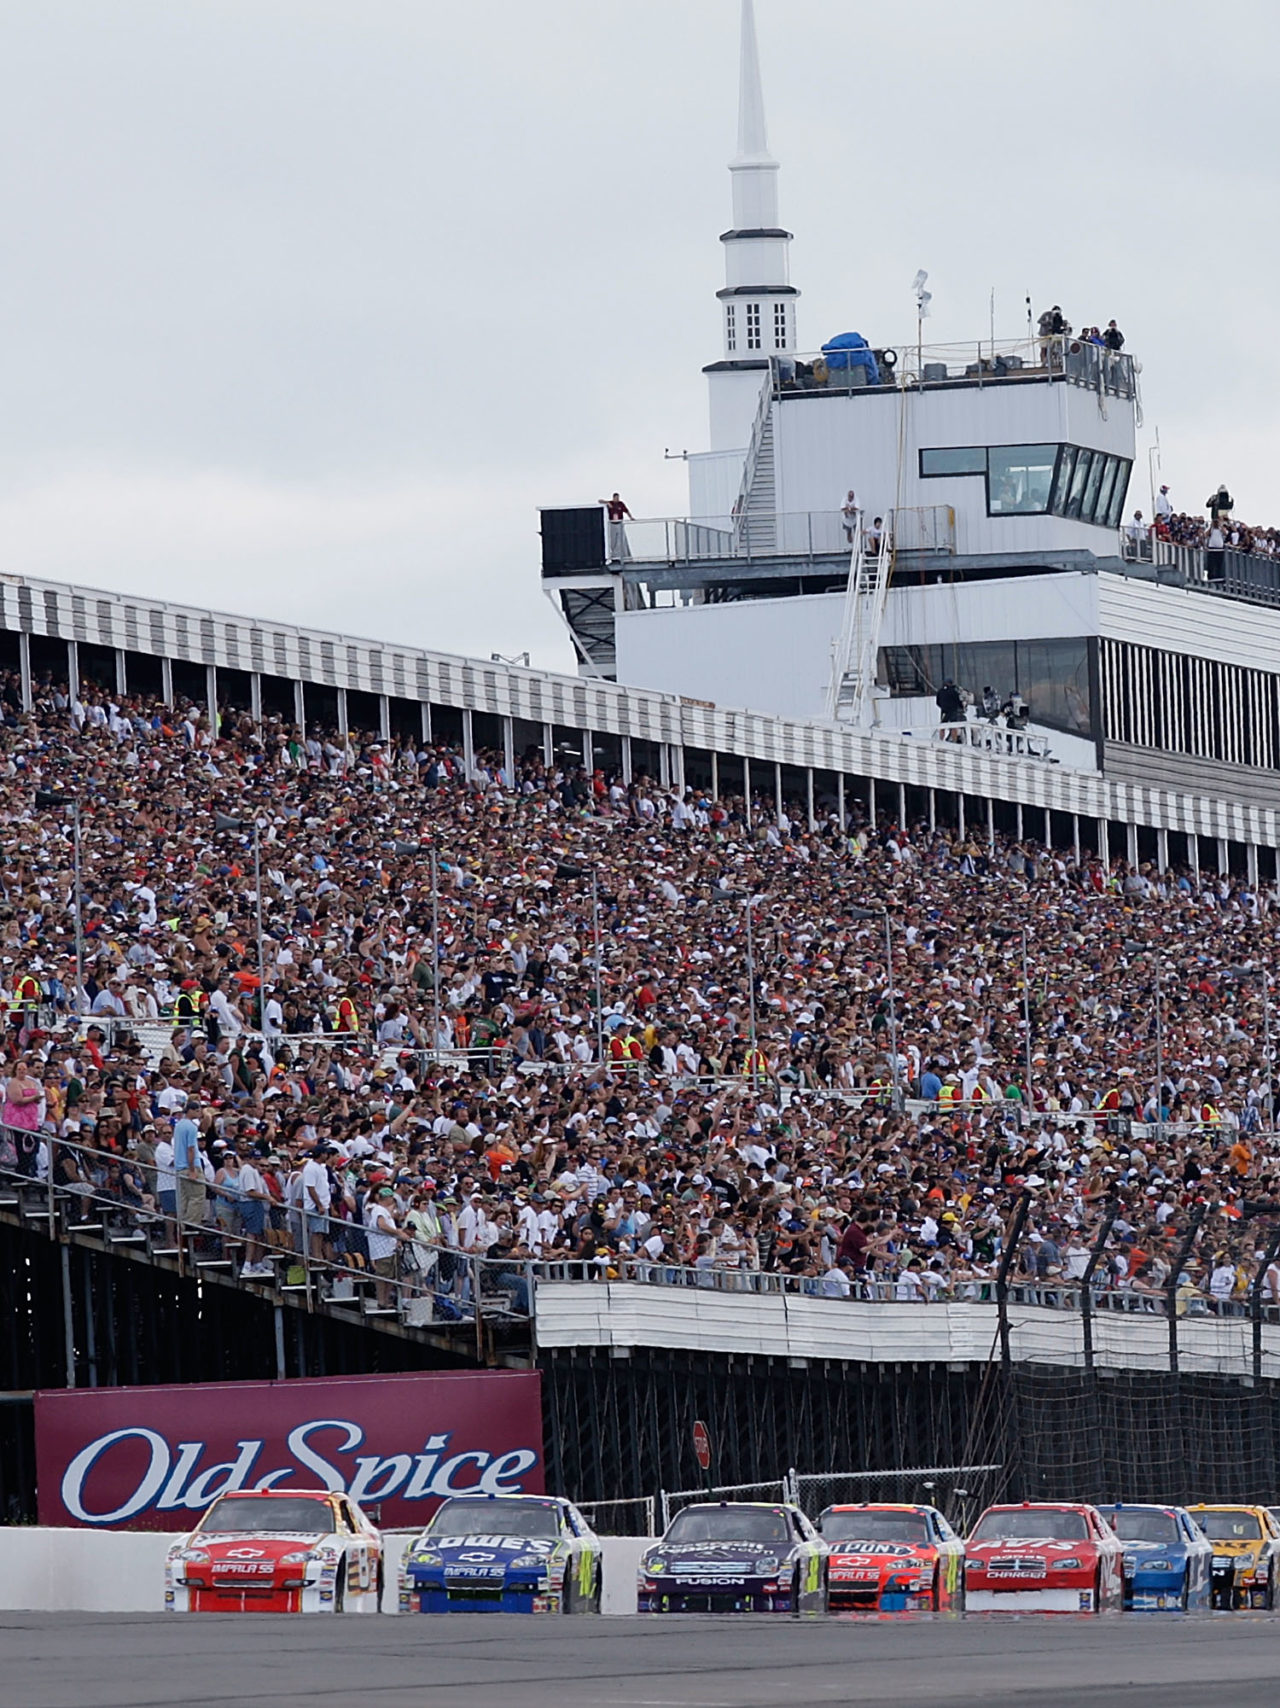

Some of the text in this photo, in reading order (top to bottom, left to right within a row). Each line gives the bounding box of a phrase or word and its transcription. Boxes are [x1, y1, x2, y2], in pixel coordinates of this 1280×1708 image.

[61, 1419, 537, 1524] Old Spice
[414, 1535, 553, 1554] LOWE'S
[211, 1565, 275, 1574] IMPALA SS
[443, 1568, 506, 1577] IMPALA SS
[829, 1571, 865, 1580] MPALA
[675, 1577, 745, 1585] FUSION
